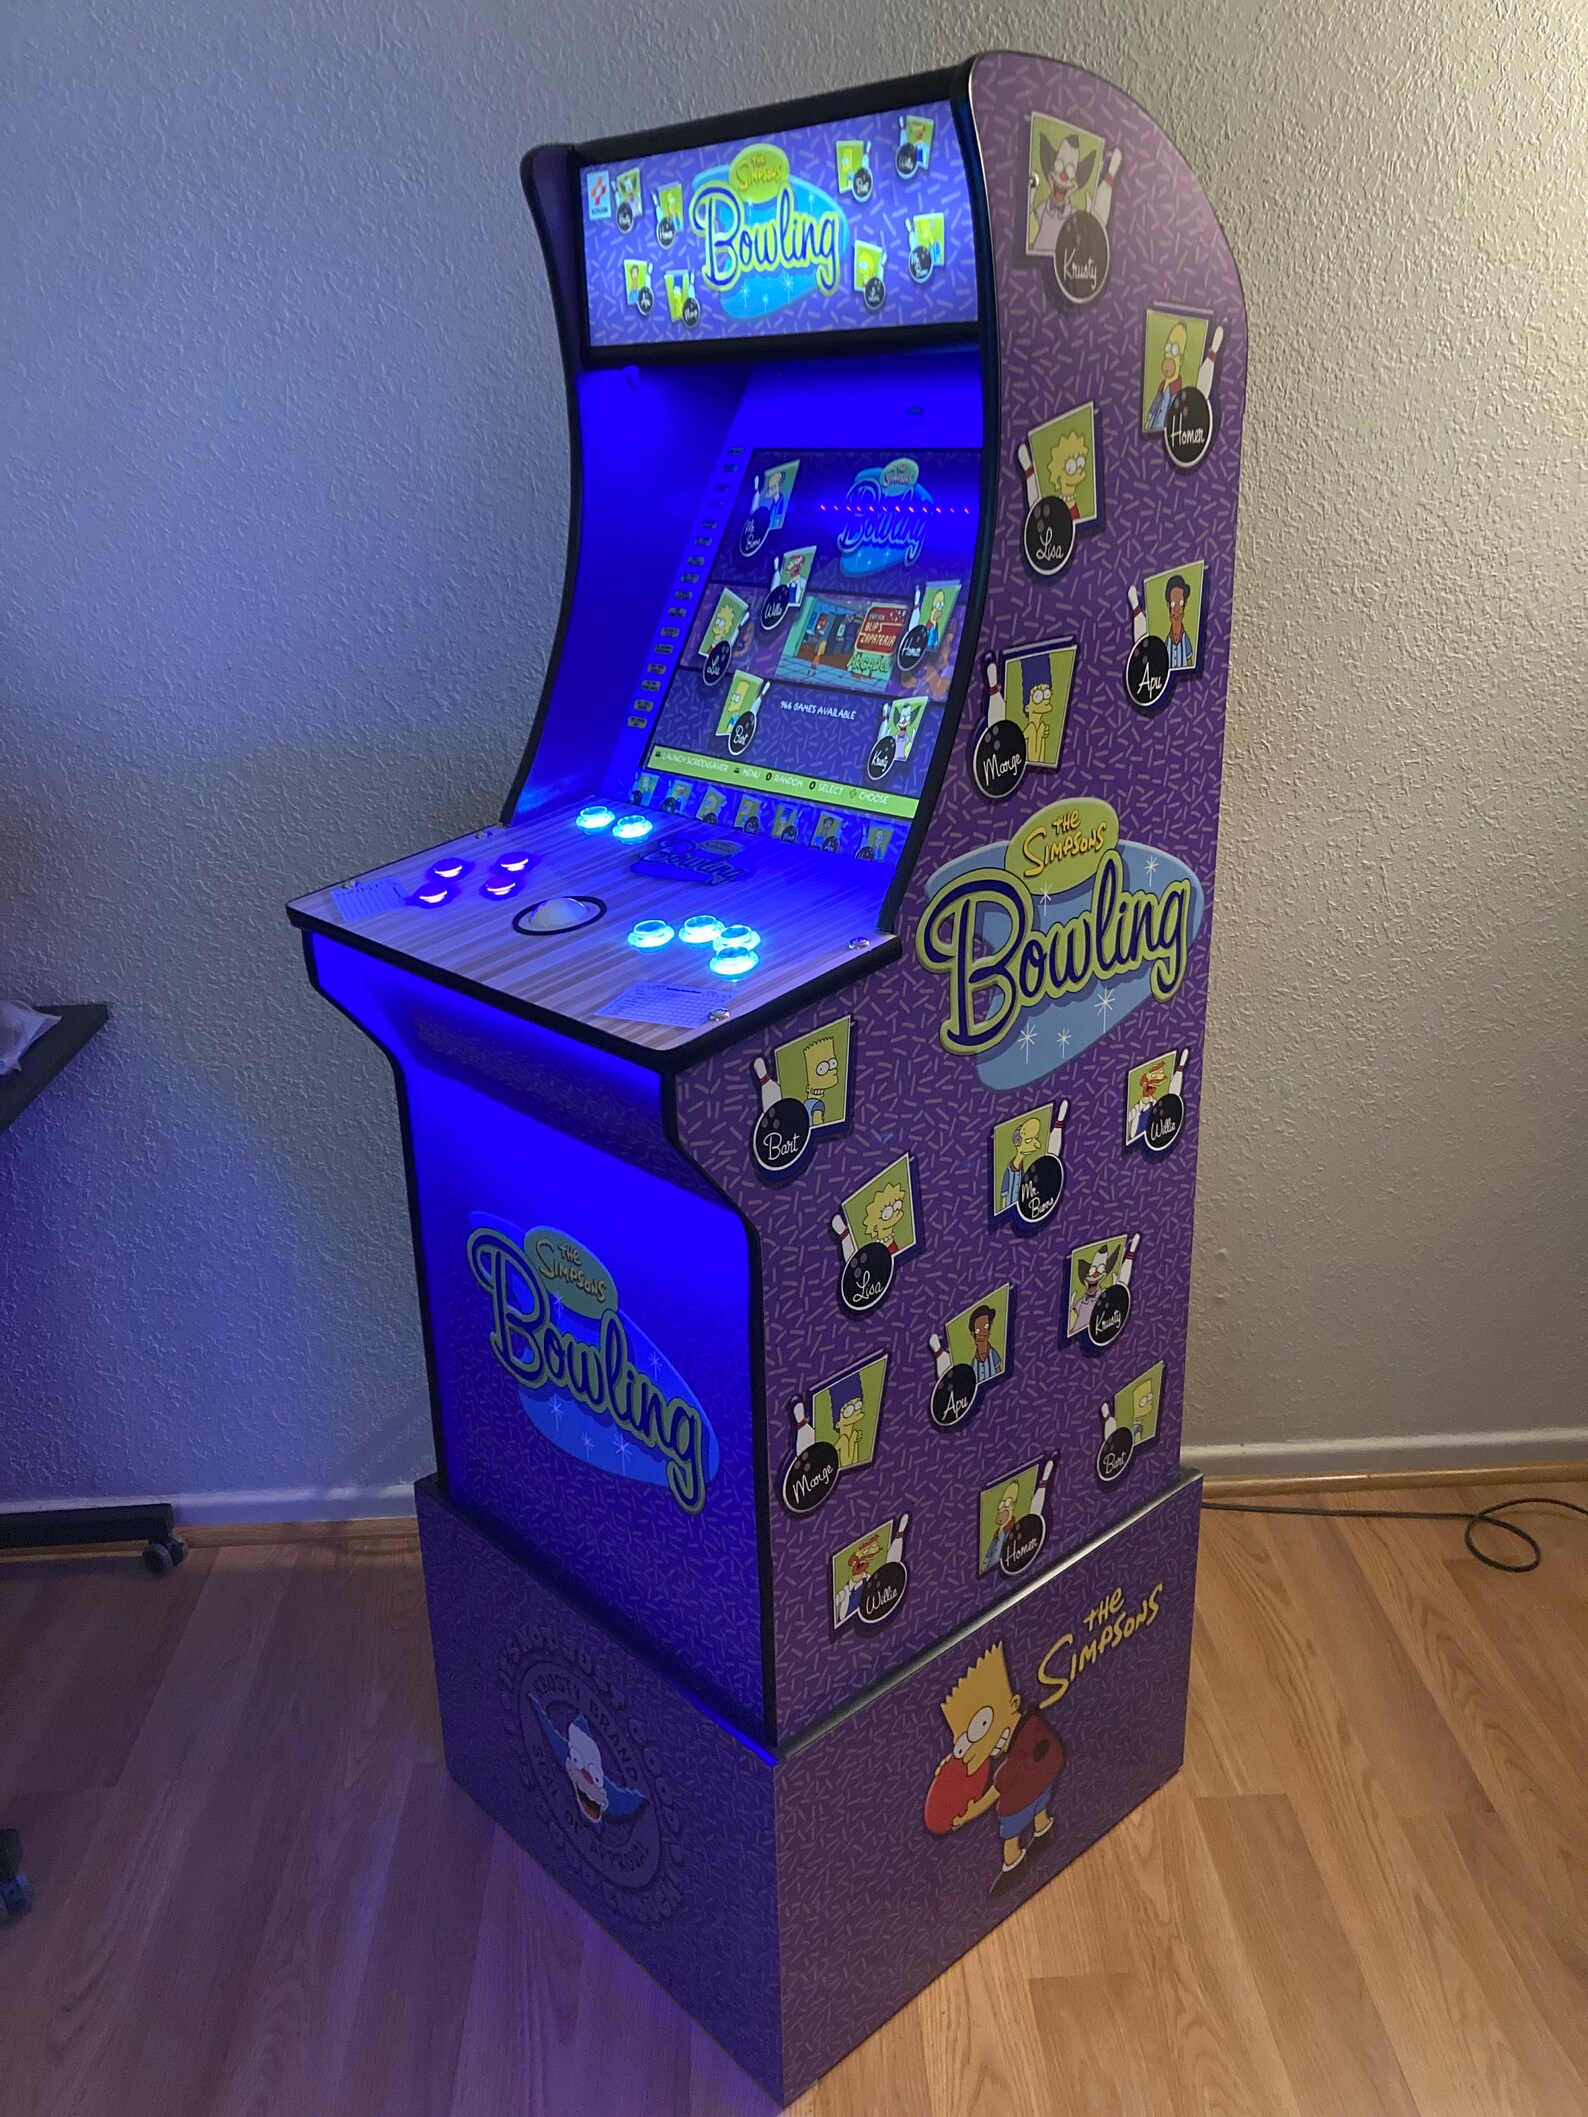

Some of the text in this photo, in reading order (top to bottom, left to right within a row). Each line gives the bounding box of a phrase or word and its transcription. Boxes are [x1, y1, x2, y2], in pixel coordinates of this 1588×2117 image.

[690, 183, 838, 293] Bowling
[1064, 250, 1097, 290] Krusty
[1170, 415, 1205, 448] Homer
[1035, 526, 1065, 562] Lisa
[901, 637, 921, 658] Homer
[1137, 661, 1162, 699] Apu
[780, 700, 857, 720] 966 GAMES AVAILABLE
[662, 752, 890, 806] LAUNCH SCREENSAVER MENU RANDOM SELECT CHOOSE
[983, 750, 1022, 788] Marge
[1052, 810, 1080, 836] THE
[1022, 821, 1107, 878] SIMPSONS
[920, 853, 1187, 1050] Bowling
[763, 1131, 801, 1161] Bart
[1149, 1119, 1177, 1142] Willie
[1021, 1180, 1040, 1203] Mr.
[536, 1238, 608, 1303] SIMPSONS
[558, 1241, 583, 1266] THE
[853, 1270, 884, 1302] Lisa
[1095, 1307, 1122, 1335] Krusty
[468, 1230, 704, 1512] Bowling
[942, 1390, 969, 1422] Apu
[1102, 1451, 1129, 1475] Bart
[792, 1462, 835, 1505] Marge
[1004, 1535, 1040, 1568] Homer
[865, 1586, 900, 1615] Willie
[1082, 1586, 1125, 1631] THE
[1037, 1583, 1164, 1709] SIMPSONS
[590, 1697, 639, 1782] BRAND
